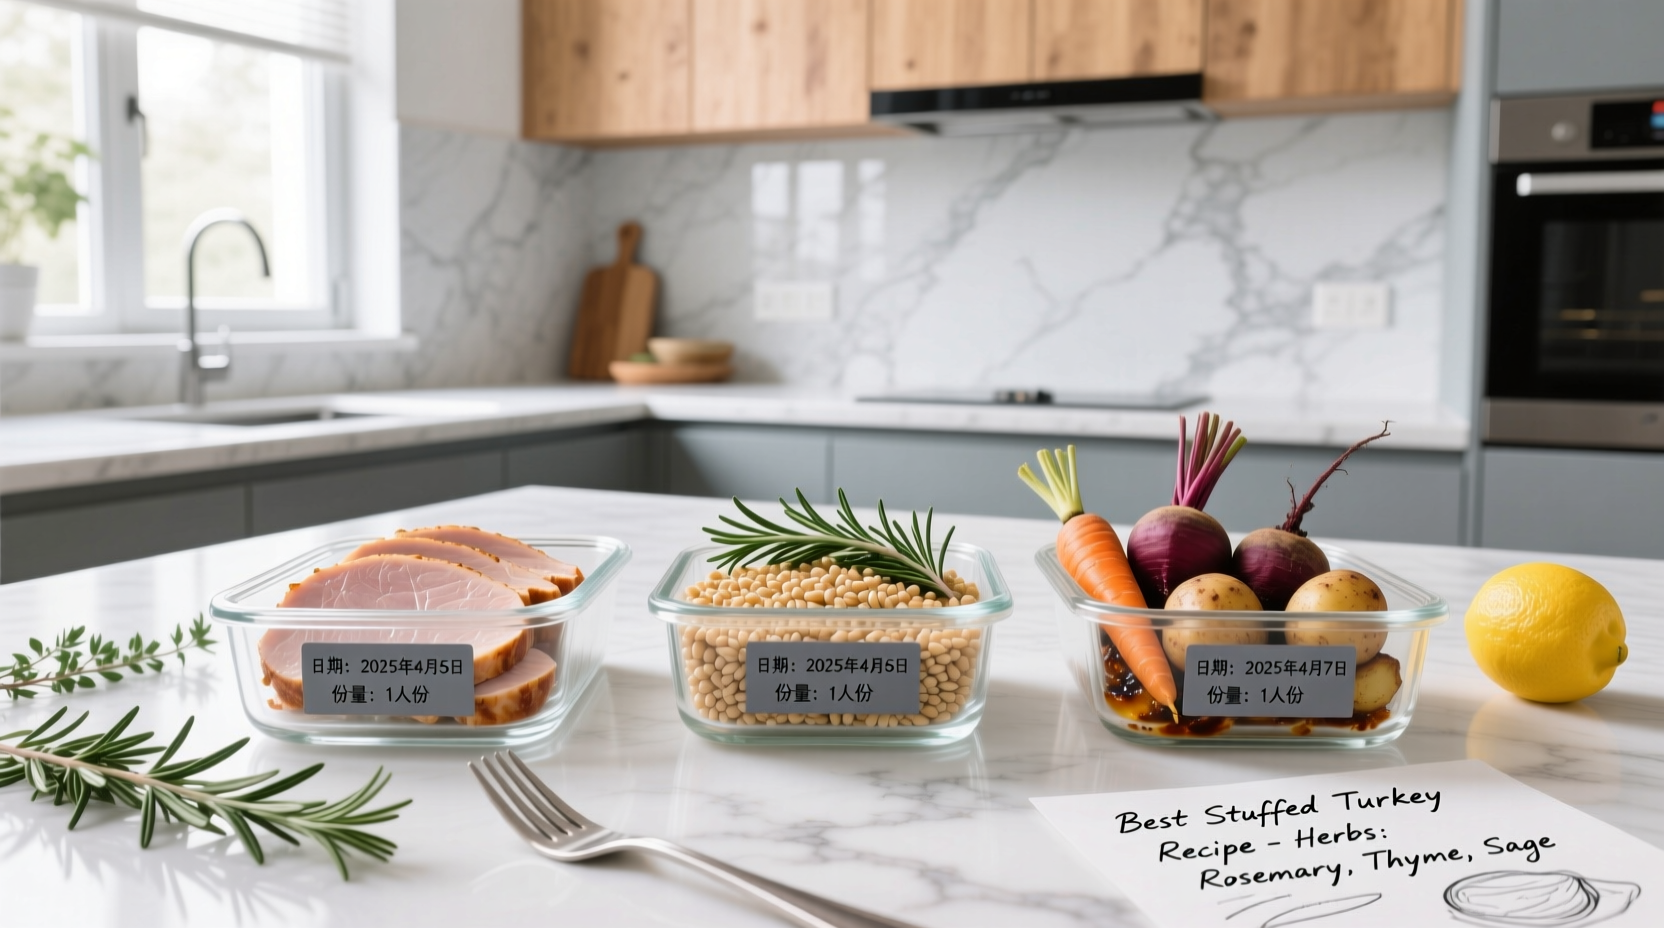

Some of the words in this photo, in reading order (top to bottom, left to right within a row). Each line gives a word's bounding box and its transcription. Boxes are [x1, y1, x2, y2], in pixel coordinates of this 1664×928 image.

[1115, 809, 1189, 834] Best
[1204, 794, 1319, 828] Stuffed
[1331, 786, 1441, 813] Turkey
[1159, 840, 1256, 866] Recipe
[1294, 822, 1387, 849] Herbs:
[1200, 863, 1353, 890] Rosemary,
[1362, 848, 1473, 877] Thyme,
[1483, 836, 1556, 863] Sage
